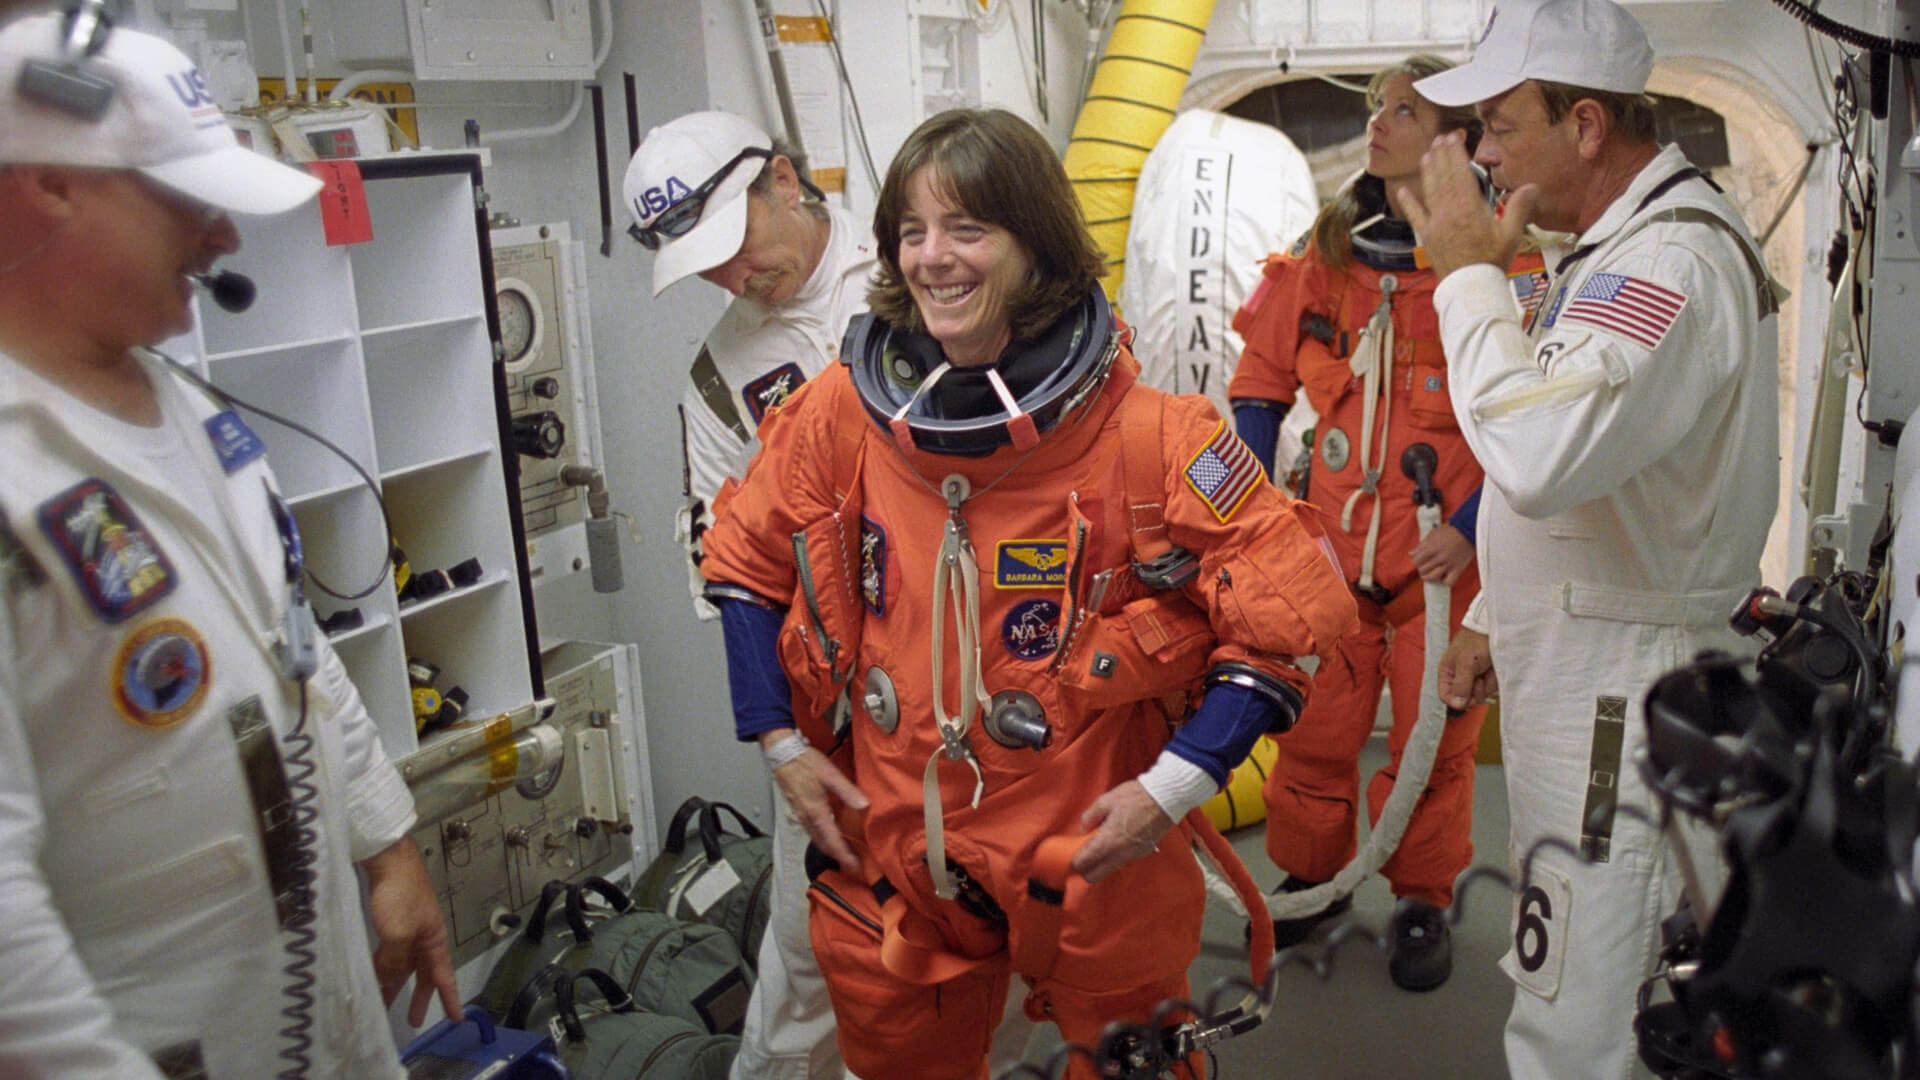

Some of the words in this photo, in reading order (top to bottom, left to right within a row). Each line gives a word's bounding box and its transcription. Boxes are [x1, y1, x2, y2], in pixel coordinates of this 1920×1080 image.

[633, 176, 694, 220] USA
[1189, 158, 1214, 394] ENDEAV
[1006, 574, 1042, 582] BARBARA
[1099, 658, 1110, 670] F
[1516, 886, 1552, 973] 6
